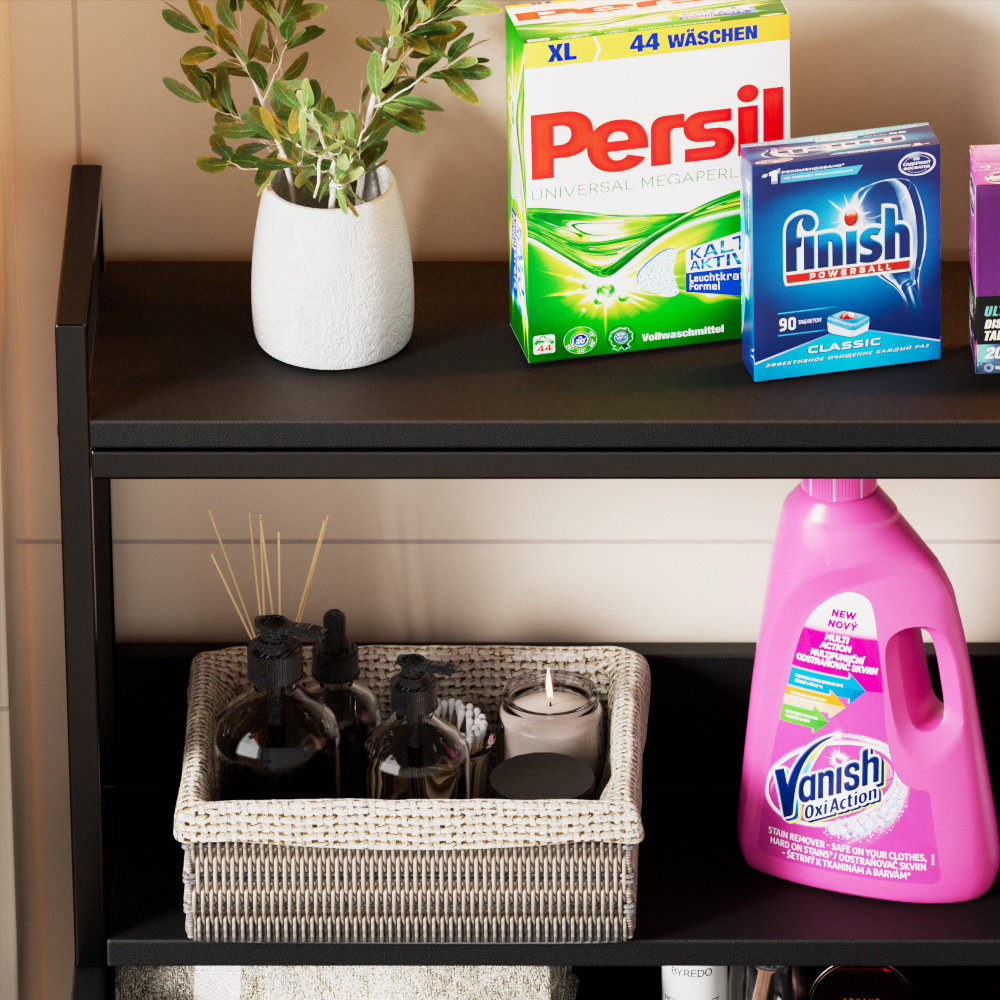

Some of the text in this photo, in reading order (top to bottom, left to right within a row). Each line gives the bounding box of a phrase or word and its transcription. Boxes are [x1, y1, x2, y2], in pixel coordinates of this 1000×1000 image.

[630, 25, 758, 52] 44 WÄSCHEN
[548, 43, 577, 62] XL
[531, 84, 783, 180] Persil
[531, 168, 738, 200] UNIVERSAL MEGAPERL
[784, 203, 912, 273] finish
[689, 271, 740, 283] Leuchtkra
[809, 263, 892, 280] POWERBALL
[689, 281, 721, 291] Formel
[778, 317, 797, 332] 90
[642, 324, 725, 343] Vollwaschmittel
[537, 344, 552, 352] 44
[807, 337, 882, 354] CLASSIC
[765, 356, 825, 369] ЭФФЕКТИВНОЕ
[827, 350, 874, 361] ОЧИЩЕНИЕ
[876, 345, 913, 355] КАЖДЫЙ
[831, 609, 857, 620] NEW
[828, 619, 858, 632] NOVÝ
[819, 640, 853, 654] ACTION
[824, 633, 850, 644] MULTI
[851, 665, 879, 676] SKVRN
[774, 736, 884, 818] Vanish
[768, 826, 789, 840] STAIN
[789, 832, 825, 848] REMOVER
[831, 843, 851, 854] SAFE
[851, 847, 864, 856] ON
[865, 849, 888, 859] YOUR
[889, 851, 928, 863] CLOTHES,
[770, 836, 927, 871] HARD ON ODSTRAŇOVAČ SKVRN
[786, 850, 872, 876] ŠETRNÝ K TKANINÁM A
[672, 966, 713, 978] BYREDO
